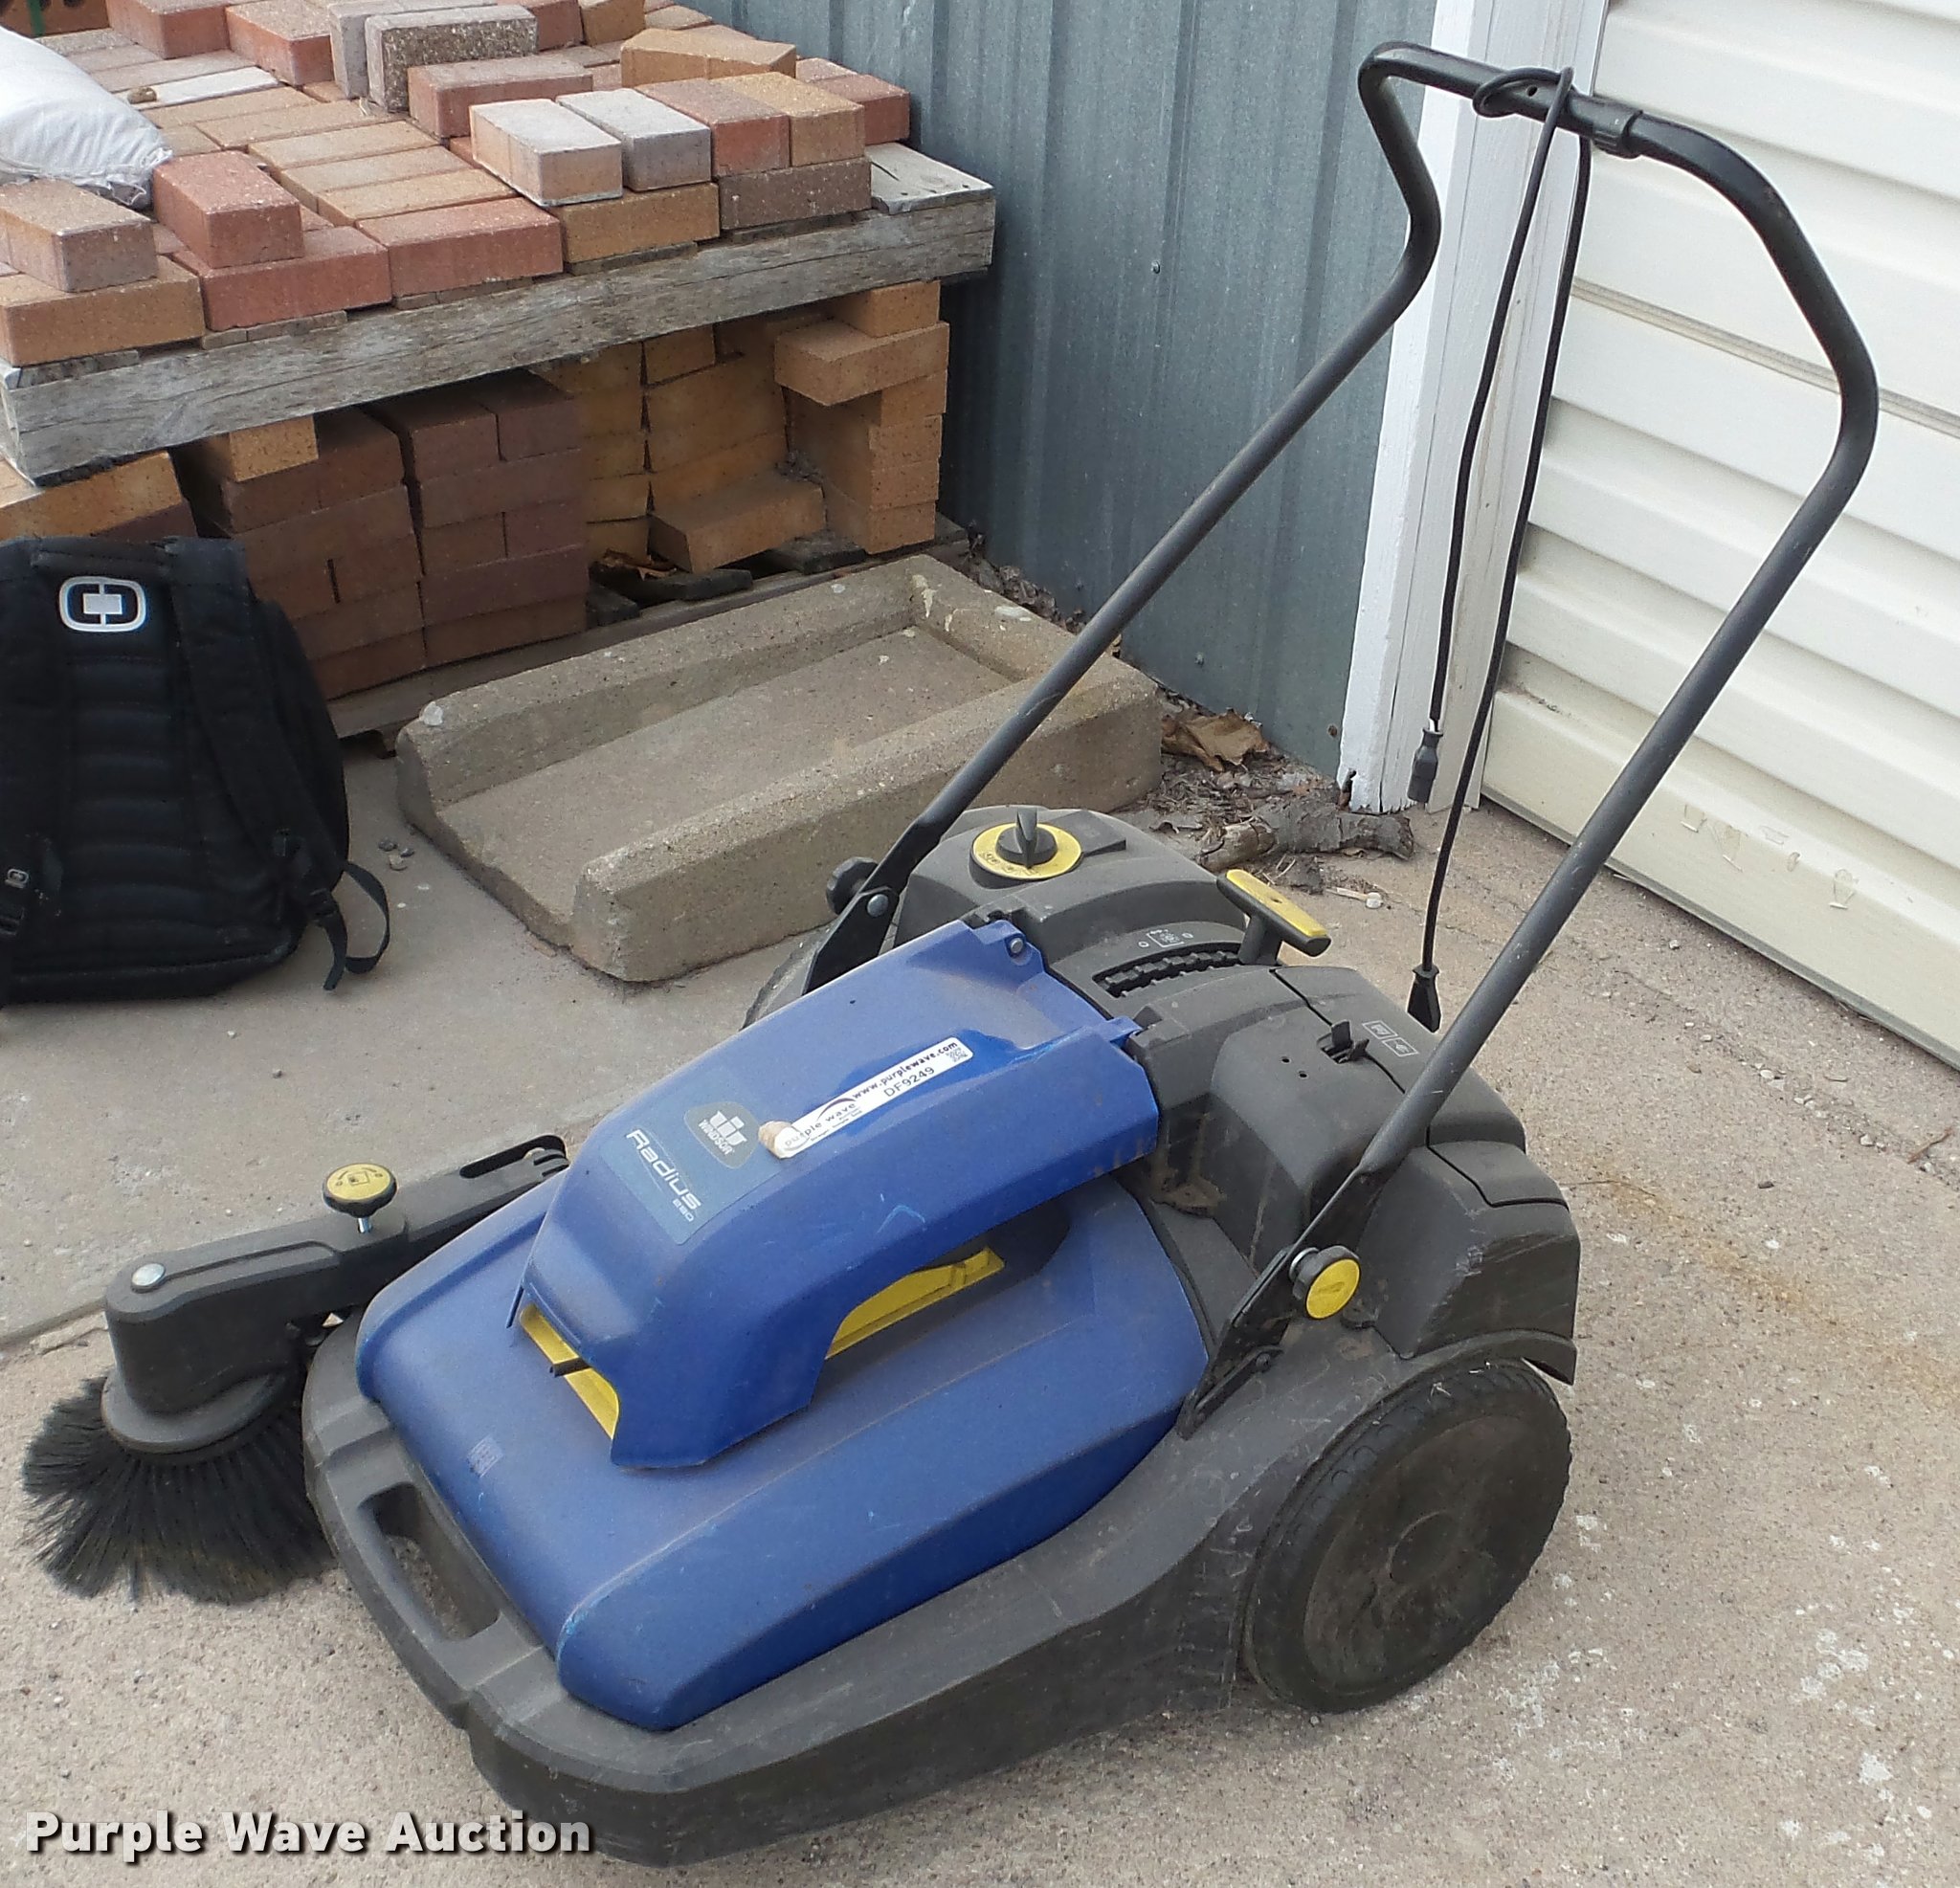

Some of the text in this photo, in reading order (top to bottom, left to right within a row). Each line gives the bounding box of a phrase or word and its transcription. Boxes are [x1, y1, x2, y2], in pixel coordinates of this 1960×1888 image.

[853, 1041, 958, 1099] www.purplewave.com
[883, 1066, 935, 1098] DF9249
[825, 1103, 856, 1122] wave
[698, 1119, 734, 1156] WINDSOR
[626, 1129, 702, 1211] Radius
